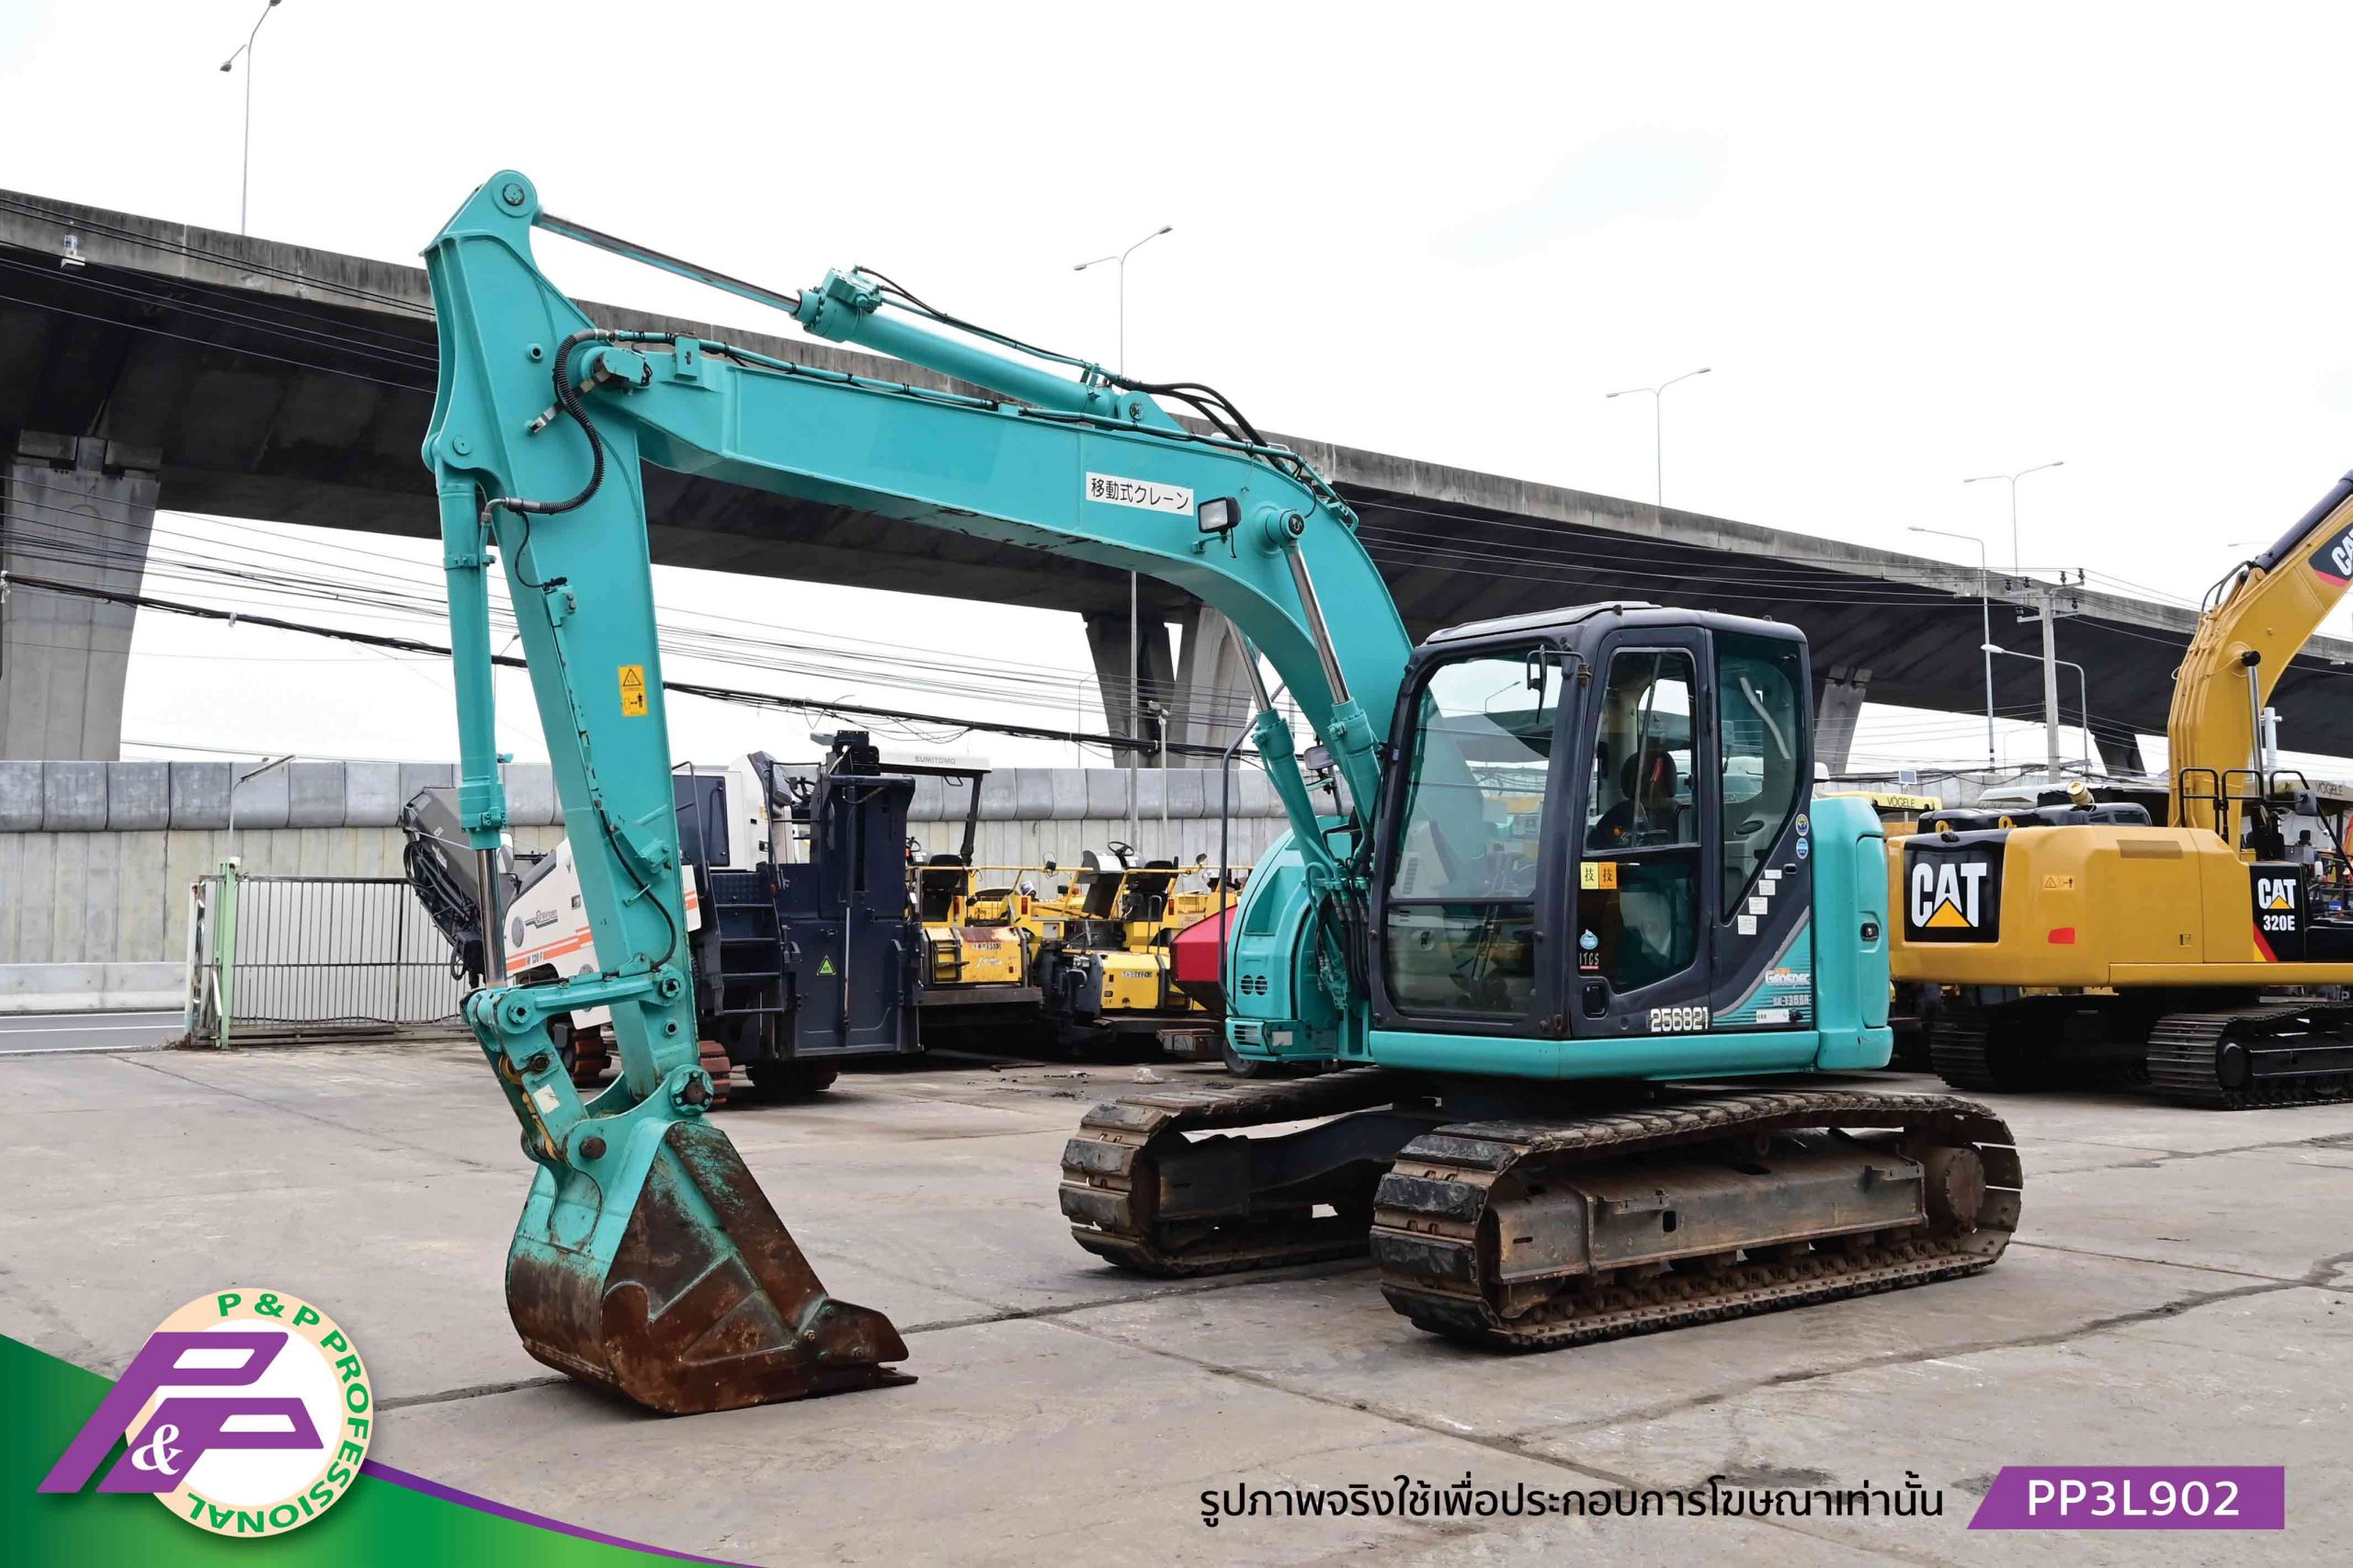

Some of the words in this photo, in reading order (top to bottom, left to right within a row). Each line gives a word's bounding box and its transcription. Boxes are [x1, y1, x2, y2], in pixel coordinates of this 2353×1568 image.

[1091, 478, 1188, 509] 移動式クレーン
[2332, 528, 2353, 575] CA
[915, 756, 957, 766] SUMITOMO
[1585, 867, 1595, 882] 技
[1603, 867, 1613, 882] 技
[1912, 863, 1987, 927] CAT
[2257, 878, 2297, 909] CAT
[2263, 915, 2296, 931] 320E
[1579, 952, 1599, 966] ITCS
[1650, 1006, 1709, 1032] 256821
